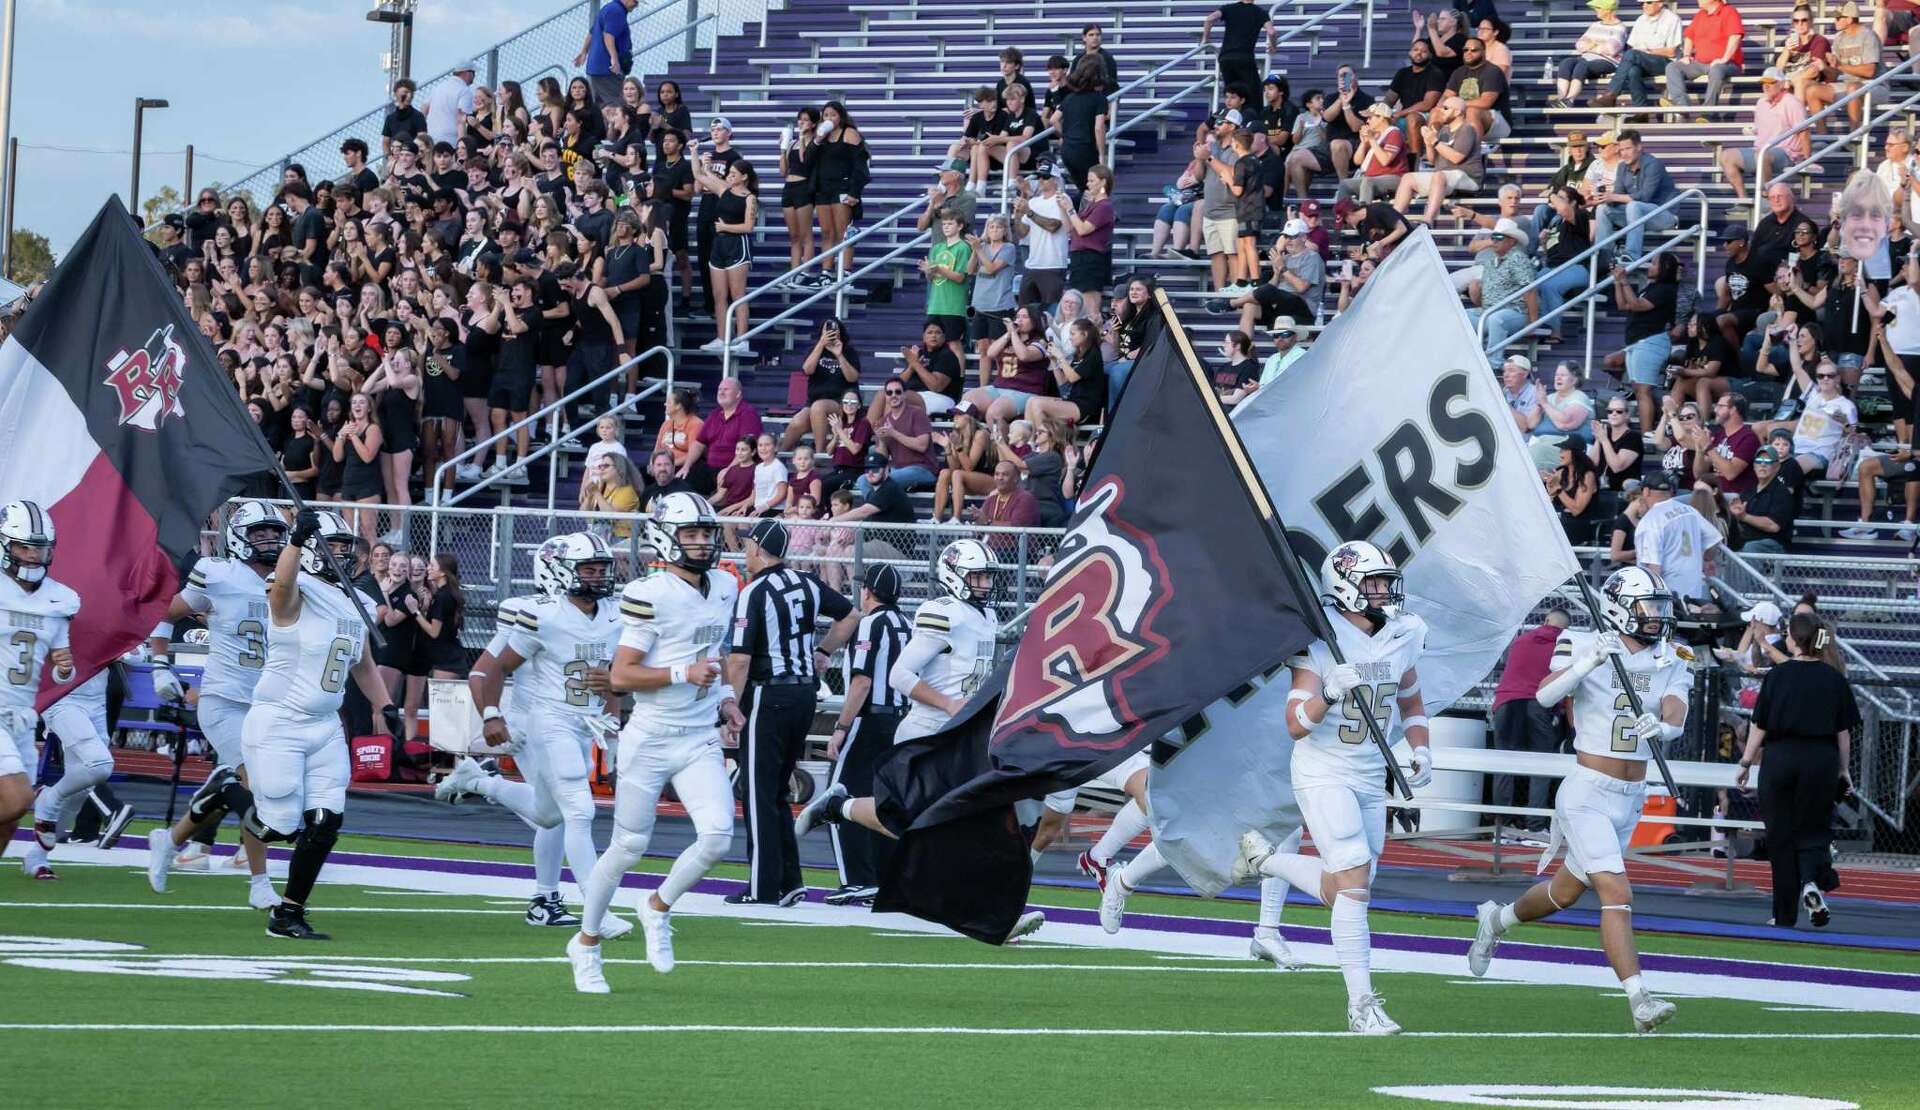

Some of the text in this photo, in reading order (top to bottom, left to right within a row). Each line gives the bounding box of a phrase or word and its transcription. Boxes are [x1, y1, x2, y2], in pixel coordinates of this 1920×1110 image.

[8, 630, 38, 685] 3
[237, 619, 268, 669] 3
[1338, 682, 1399, 745] 95
[1611, 692, 1643, 753] 2
